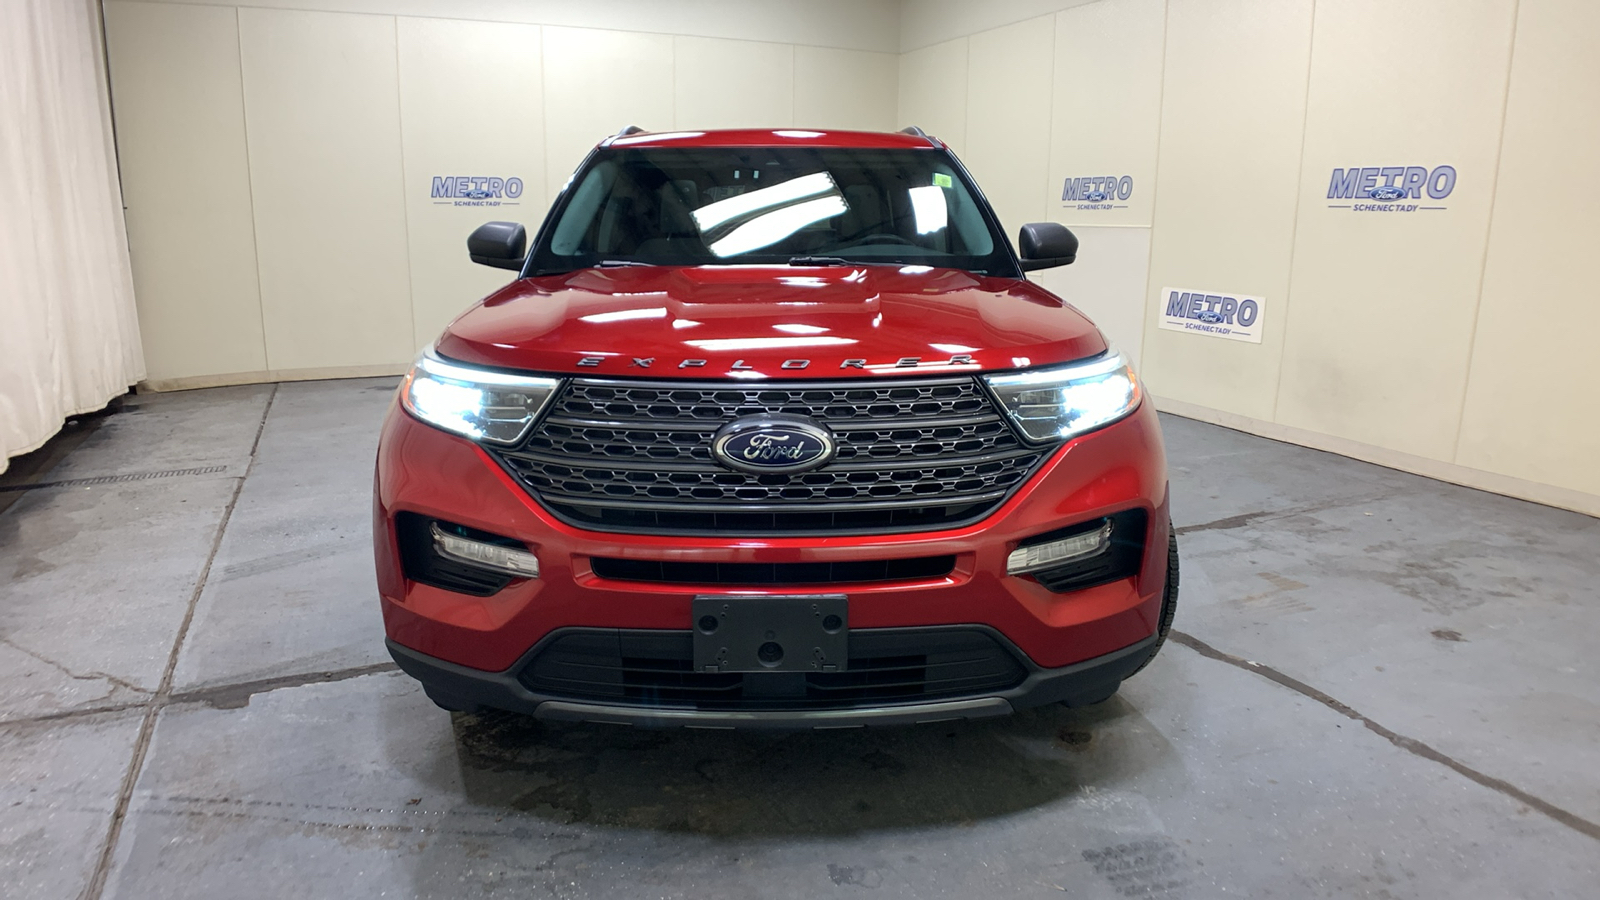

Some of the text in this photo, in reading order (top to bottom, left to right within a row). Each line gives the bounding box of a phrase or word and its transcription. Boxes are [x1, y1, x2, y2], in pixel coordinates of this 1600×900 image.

[431, 176, 524, 199] METRO
[1062, 175, 1133, 201] METRO
[1326, 165, 1457, 200] METRO
[1375, 188, 1399, 200] Ford
[1353, 204, 1419, 212] SCHENECTADY
[1166, 291, 1258, 327] METRO
[1185, 322, 1232, 335] SCHENECTADY
[576, 354, 973, 369] EXPLORER
[743, 434, 805, 460] Ford
